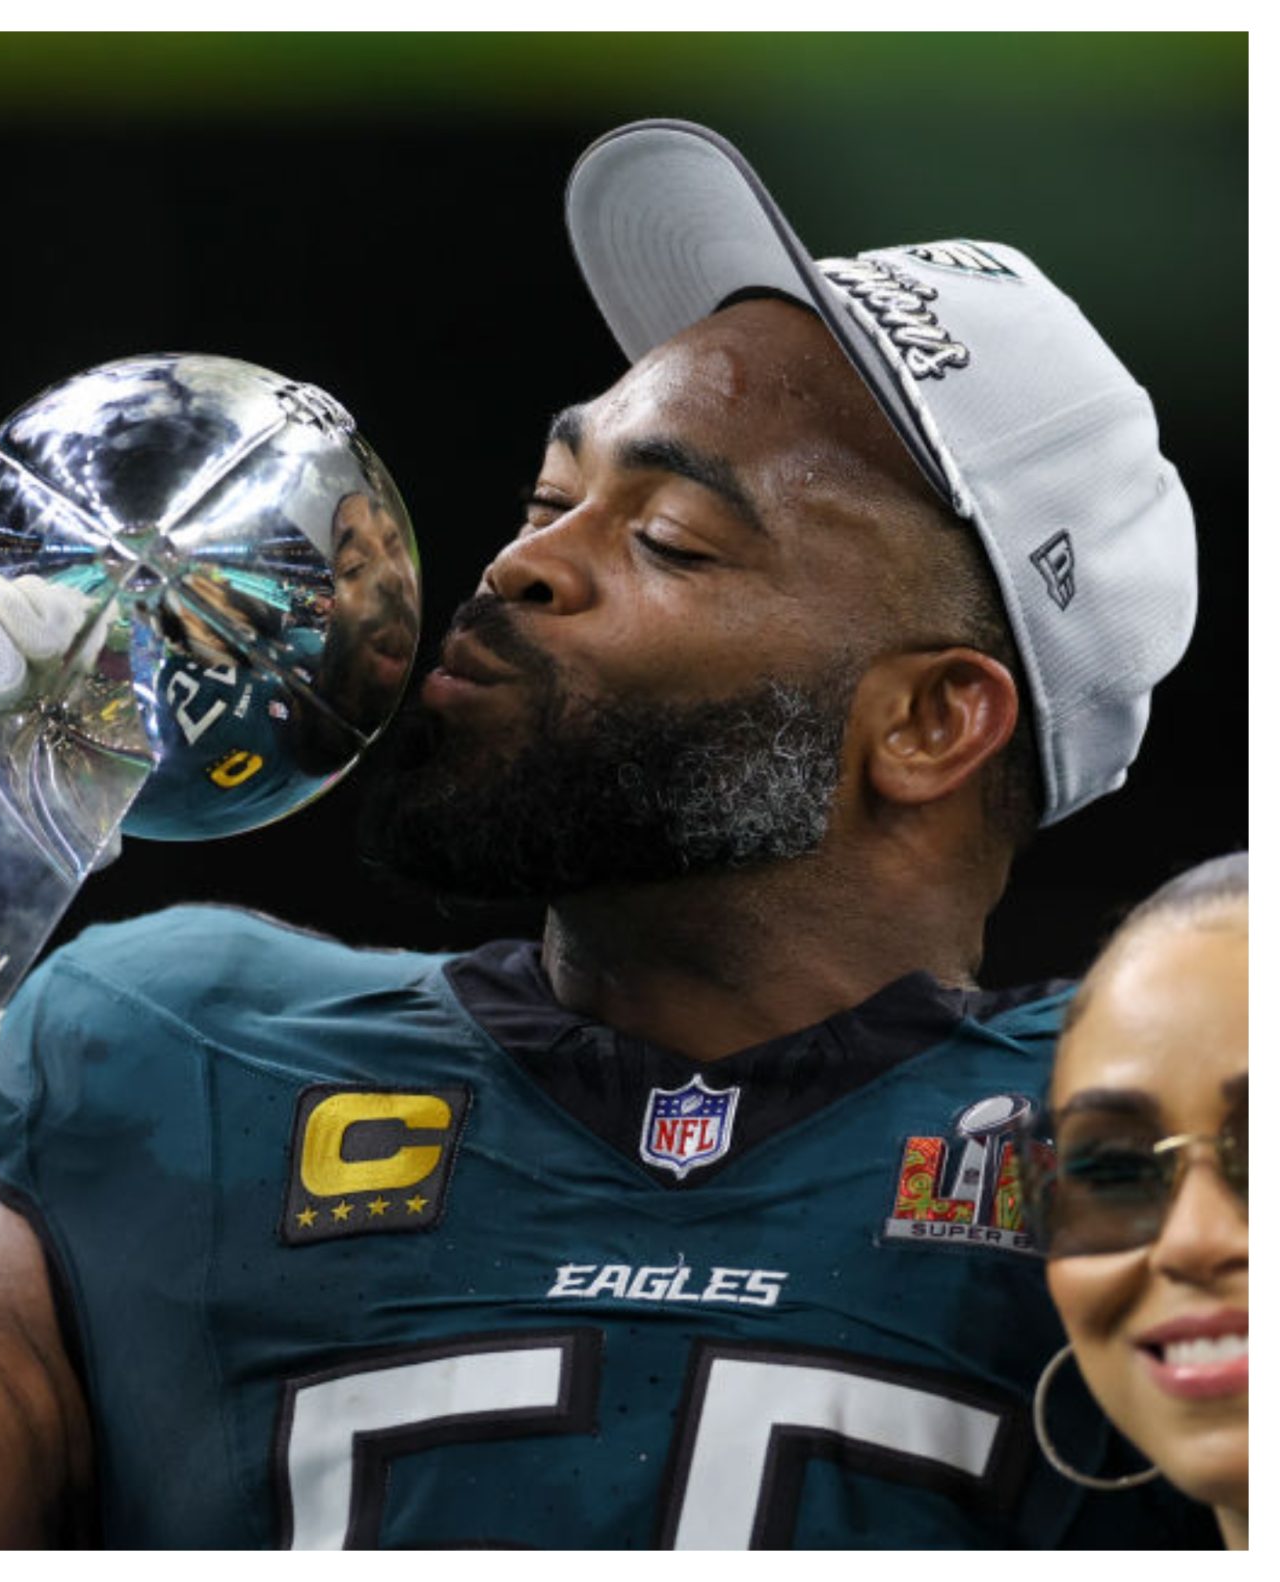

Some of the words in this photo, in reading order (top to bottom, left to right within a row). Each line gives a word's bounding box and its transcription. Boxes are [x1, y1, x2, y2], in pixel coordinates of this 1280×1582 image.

[300, 1093, 452, 1196] C
[654, 1119, 715, 1157] NFL
[911, 1222, 1001, 1244] SUPER
[547, 1264, 789, 1307] EAGLES
